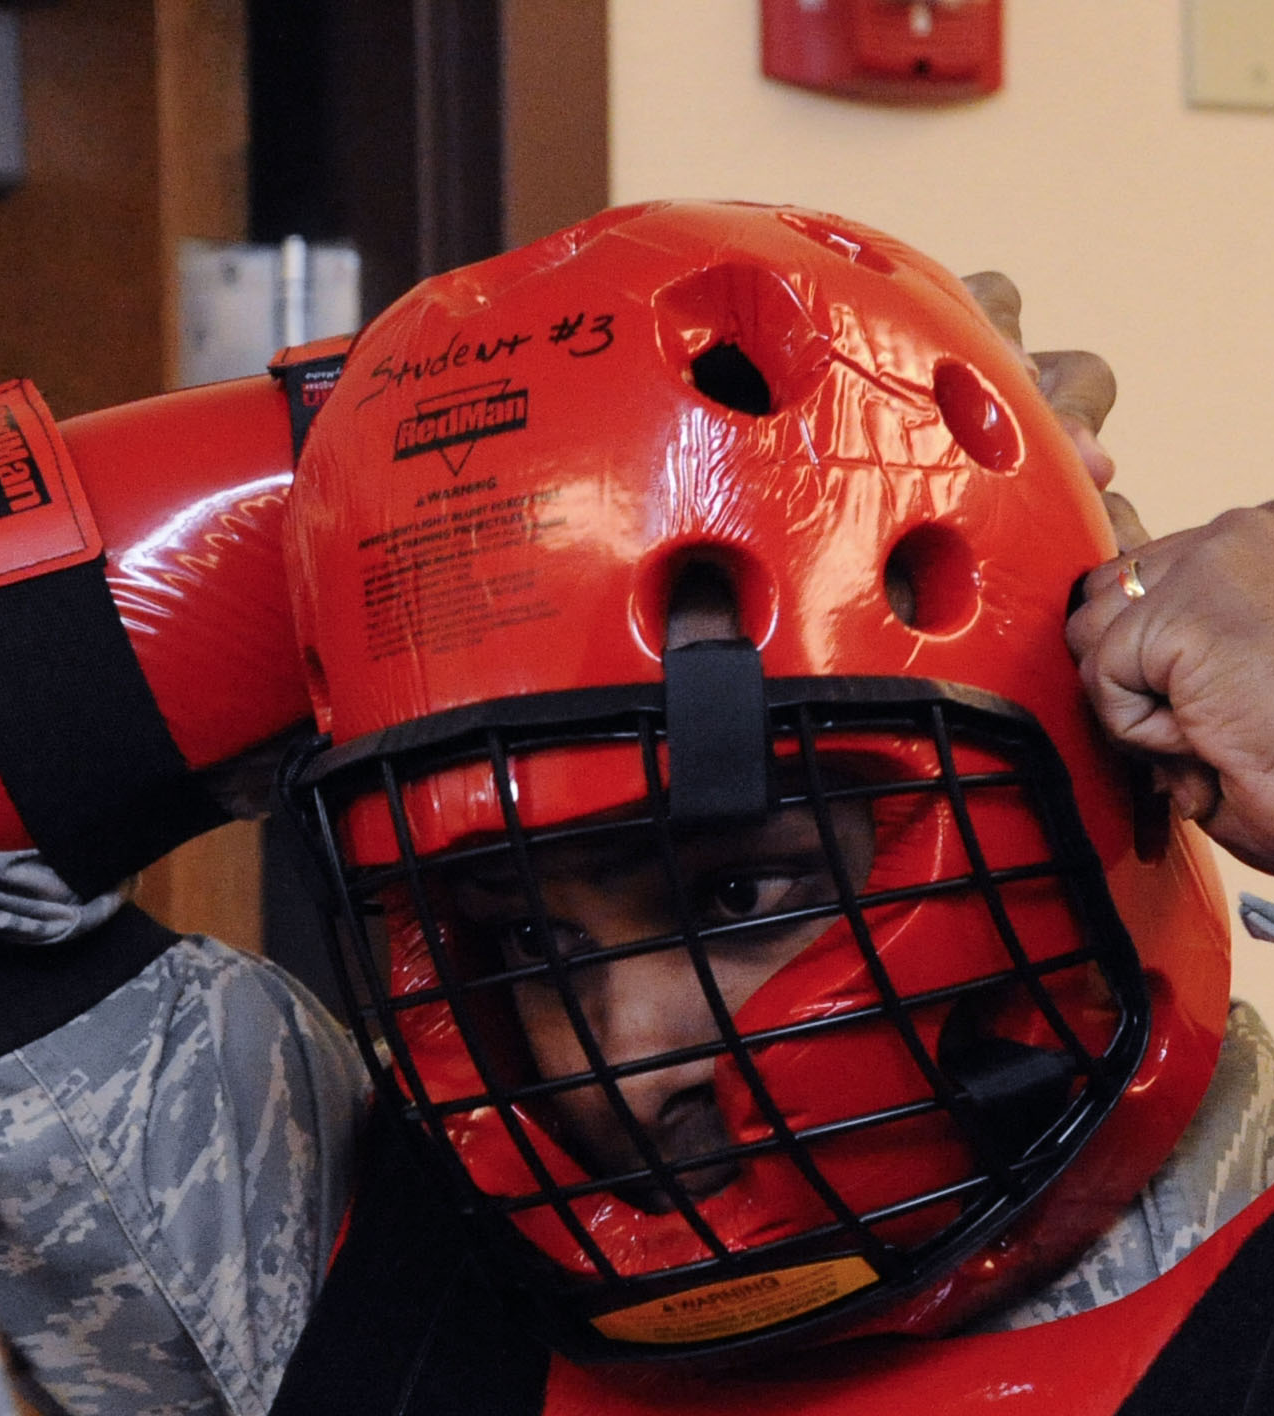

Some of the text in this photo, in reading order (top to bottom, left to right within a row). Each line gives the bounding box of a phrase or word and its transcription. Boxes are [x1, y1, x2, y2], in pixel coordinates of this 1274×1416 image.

[355, 331, 532, 412] Student
[548, 312, 615, 357] #3
[397, 394, 526, 450] RedMan
[428, 476, 498, 500] WARNING
